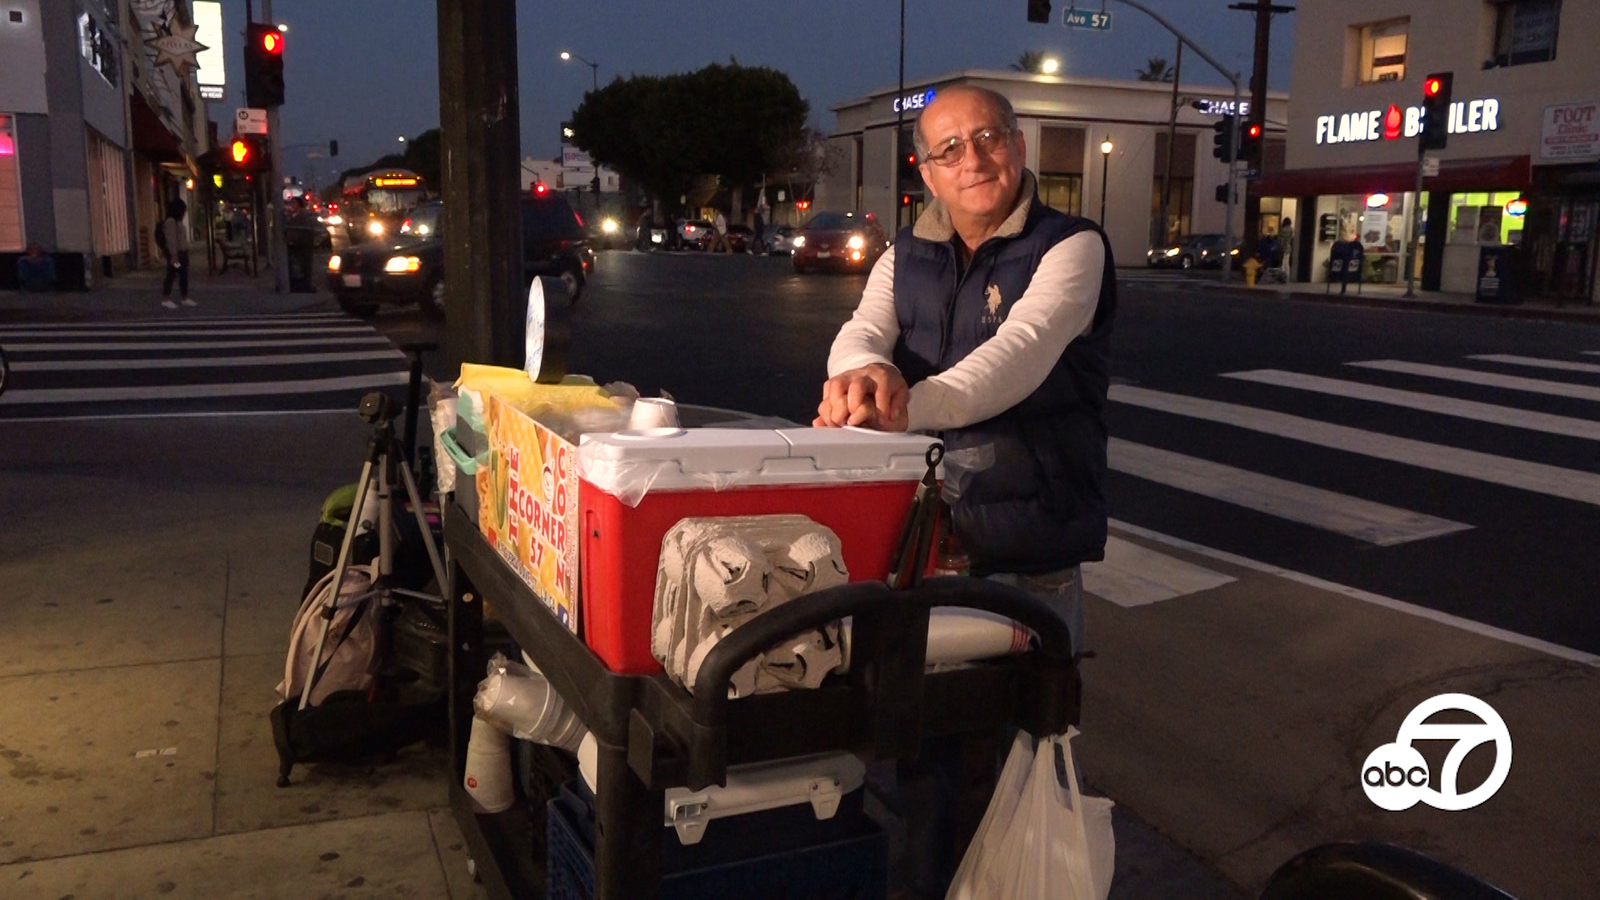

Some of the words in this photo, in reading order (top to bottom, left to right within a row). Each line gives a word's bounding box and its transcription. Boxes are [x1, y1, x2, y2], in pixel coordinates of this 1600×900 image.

[1067, 13, 1086, 25] Ave
[1091, 13, 1109, 27] 57
[893, 92, 925, 112] CHASE
[1552, 105, 1596, 124] FOOT
[1315, 110, 1382, 145] FLAME
[1404, 98, 1499, 137] BILER
[519, 494, 566, 554] CORNER
[530, 537, 544, 570] 57
